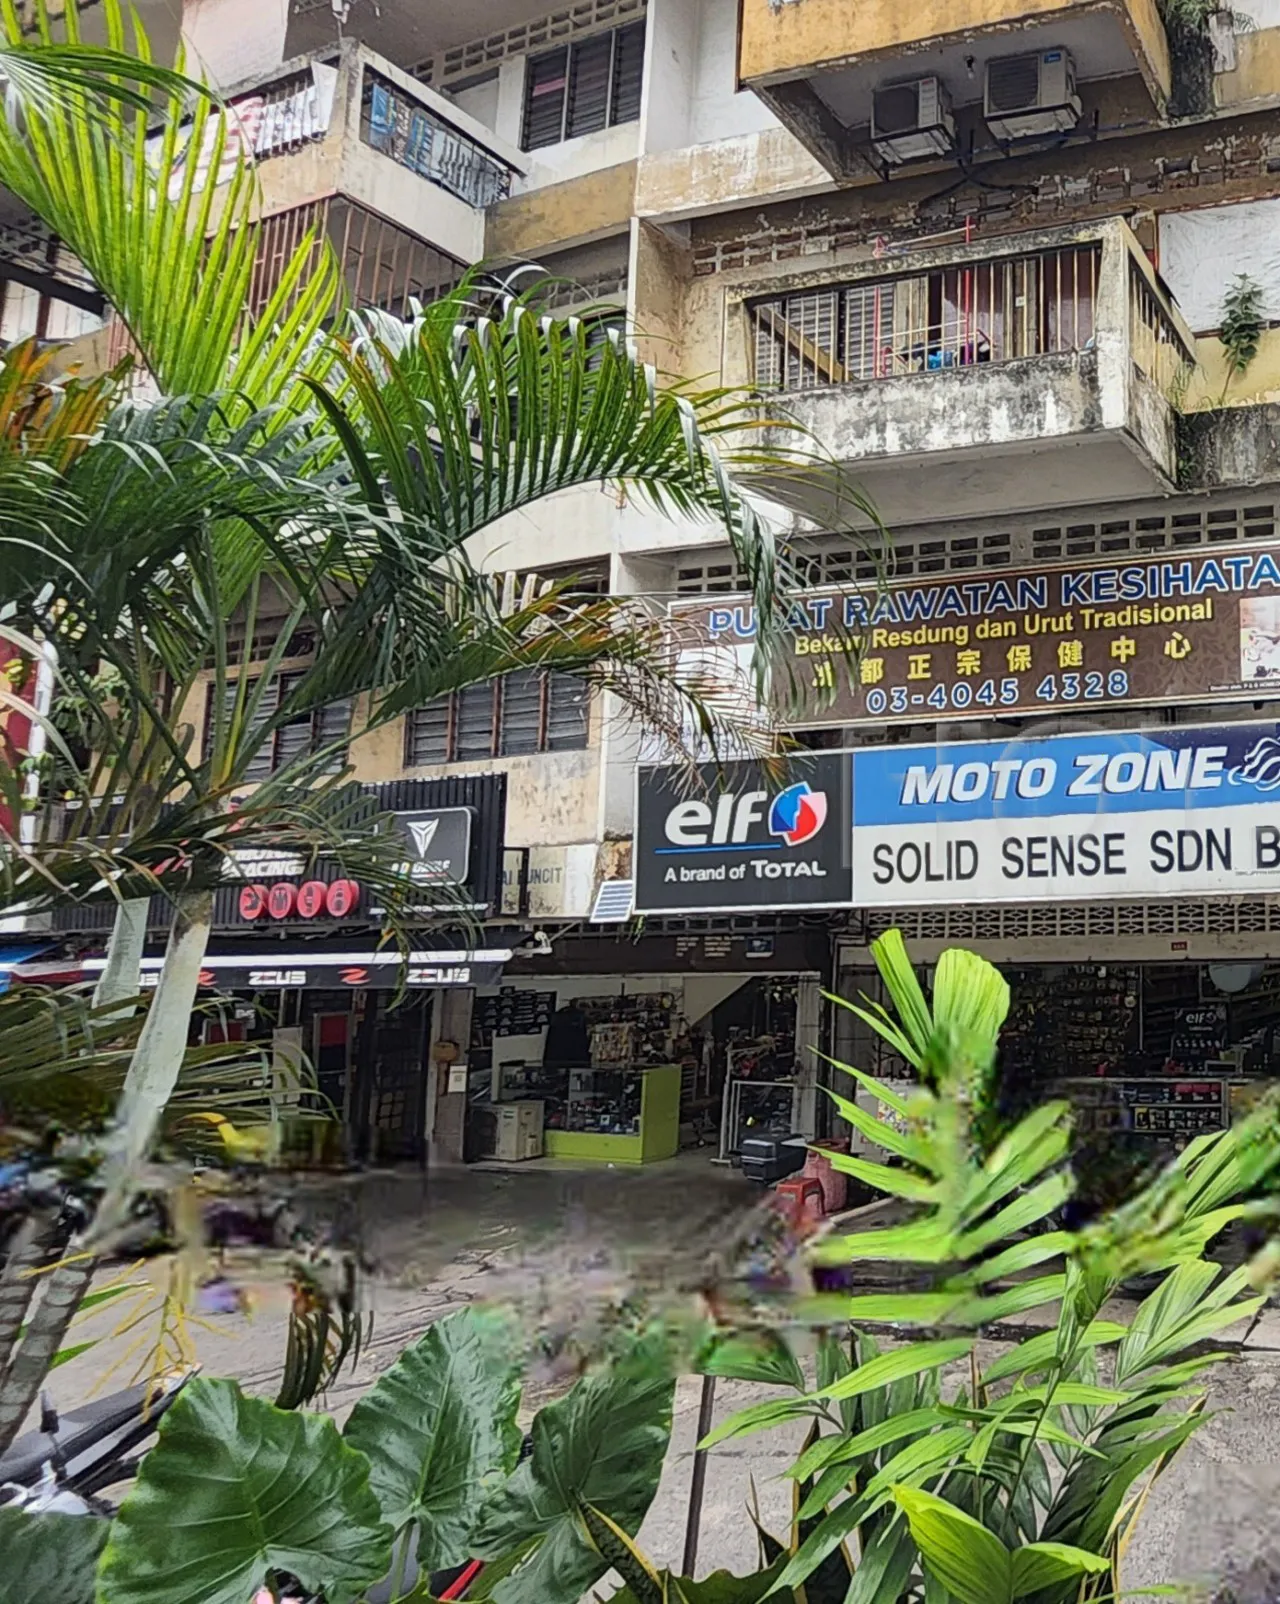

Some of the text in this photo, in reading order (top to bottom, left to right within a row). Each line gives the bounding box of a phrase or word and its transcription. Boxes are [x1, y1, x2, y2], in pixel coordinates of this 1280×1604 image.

[708, 597, 833, 640] PUAT
[842, 575, 1049, 628] RAWATAN
[872, 624, 968, 650] Resdung
[975, 619, 1017, 639] dan
[1023, 610, 1074, 635] Urut
[1079, 598, 1213, 630] Tradisional
[866, 669, 1129, 714] 03-4045 4328
[900, 746, 1228, 805] MOTO ZONE
[664, 790, 768, 846] elf
[664, 860, 827, 883] A brand of TOTAL
[872, 840, 979, 884] SOLID
[1001, 832, 1126, 879] SENSE
[1149, 827, 1232, 875] SDN
[248, 969, 307, 985] ZEUS
